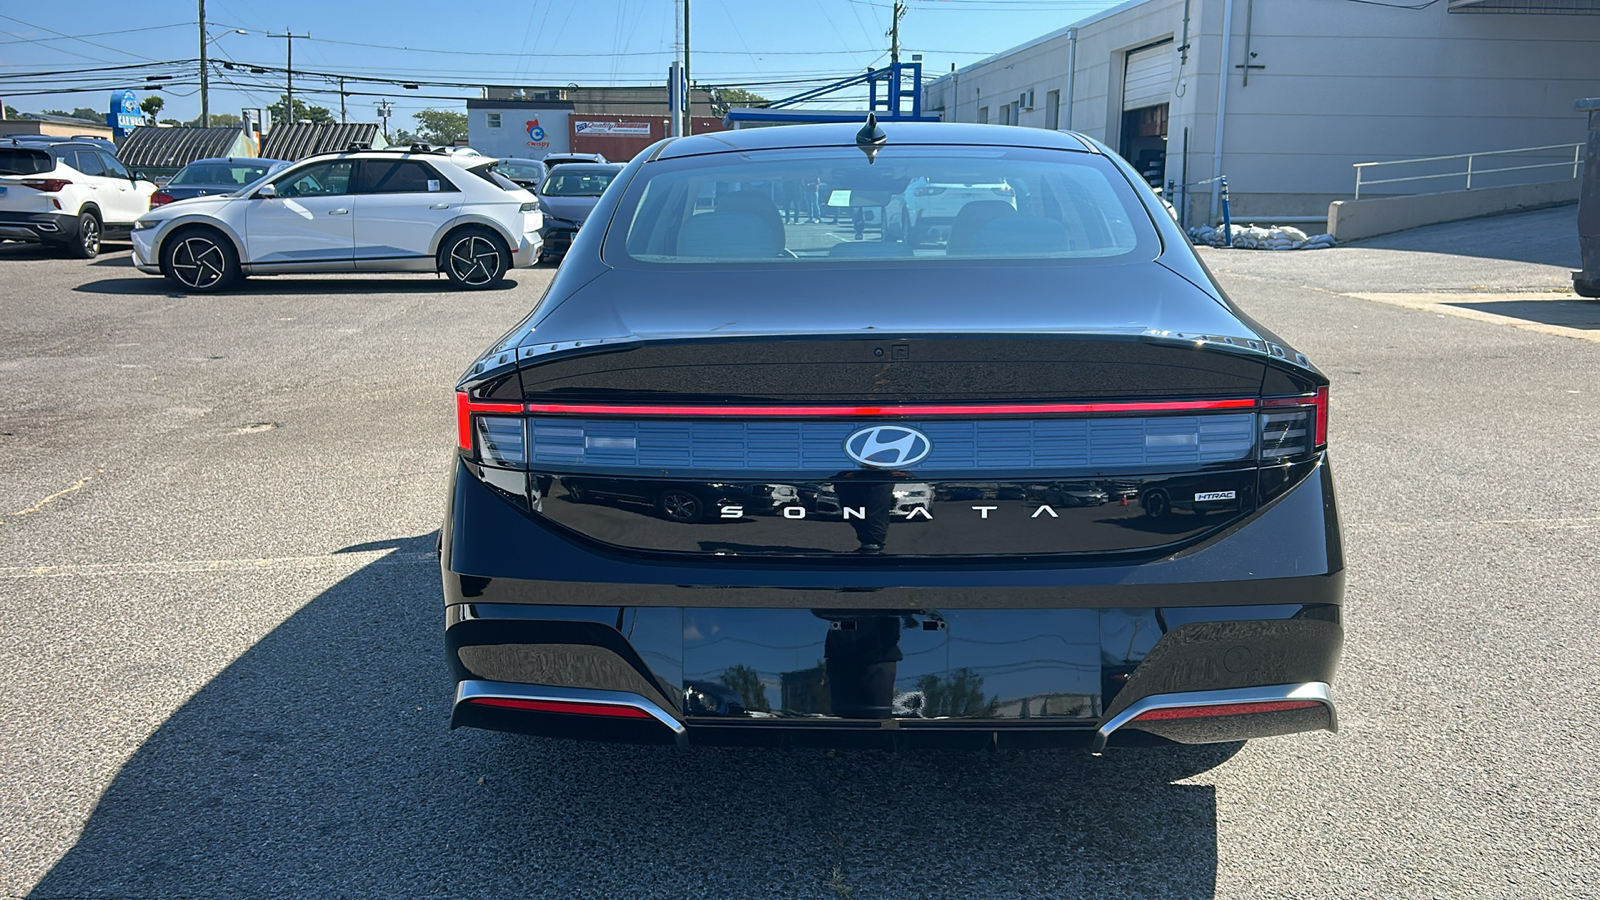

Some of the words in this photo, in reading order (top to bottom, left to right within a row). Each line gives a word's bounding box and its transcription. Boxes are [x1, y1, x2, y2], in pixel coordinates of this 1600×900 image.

[118, 116, 130, 126] CAR
[130, 116, 145, 126] WASH
[587, 122, 614, 130] Quality
[720, 505, 1059, 520] SONATA
